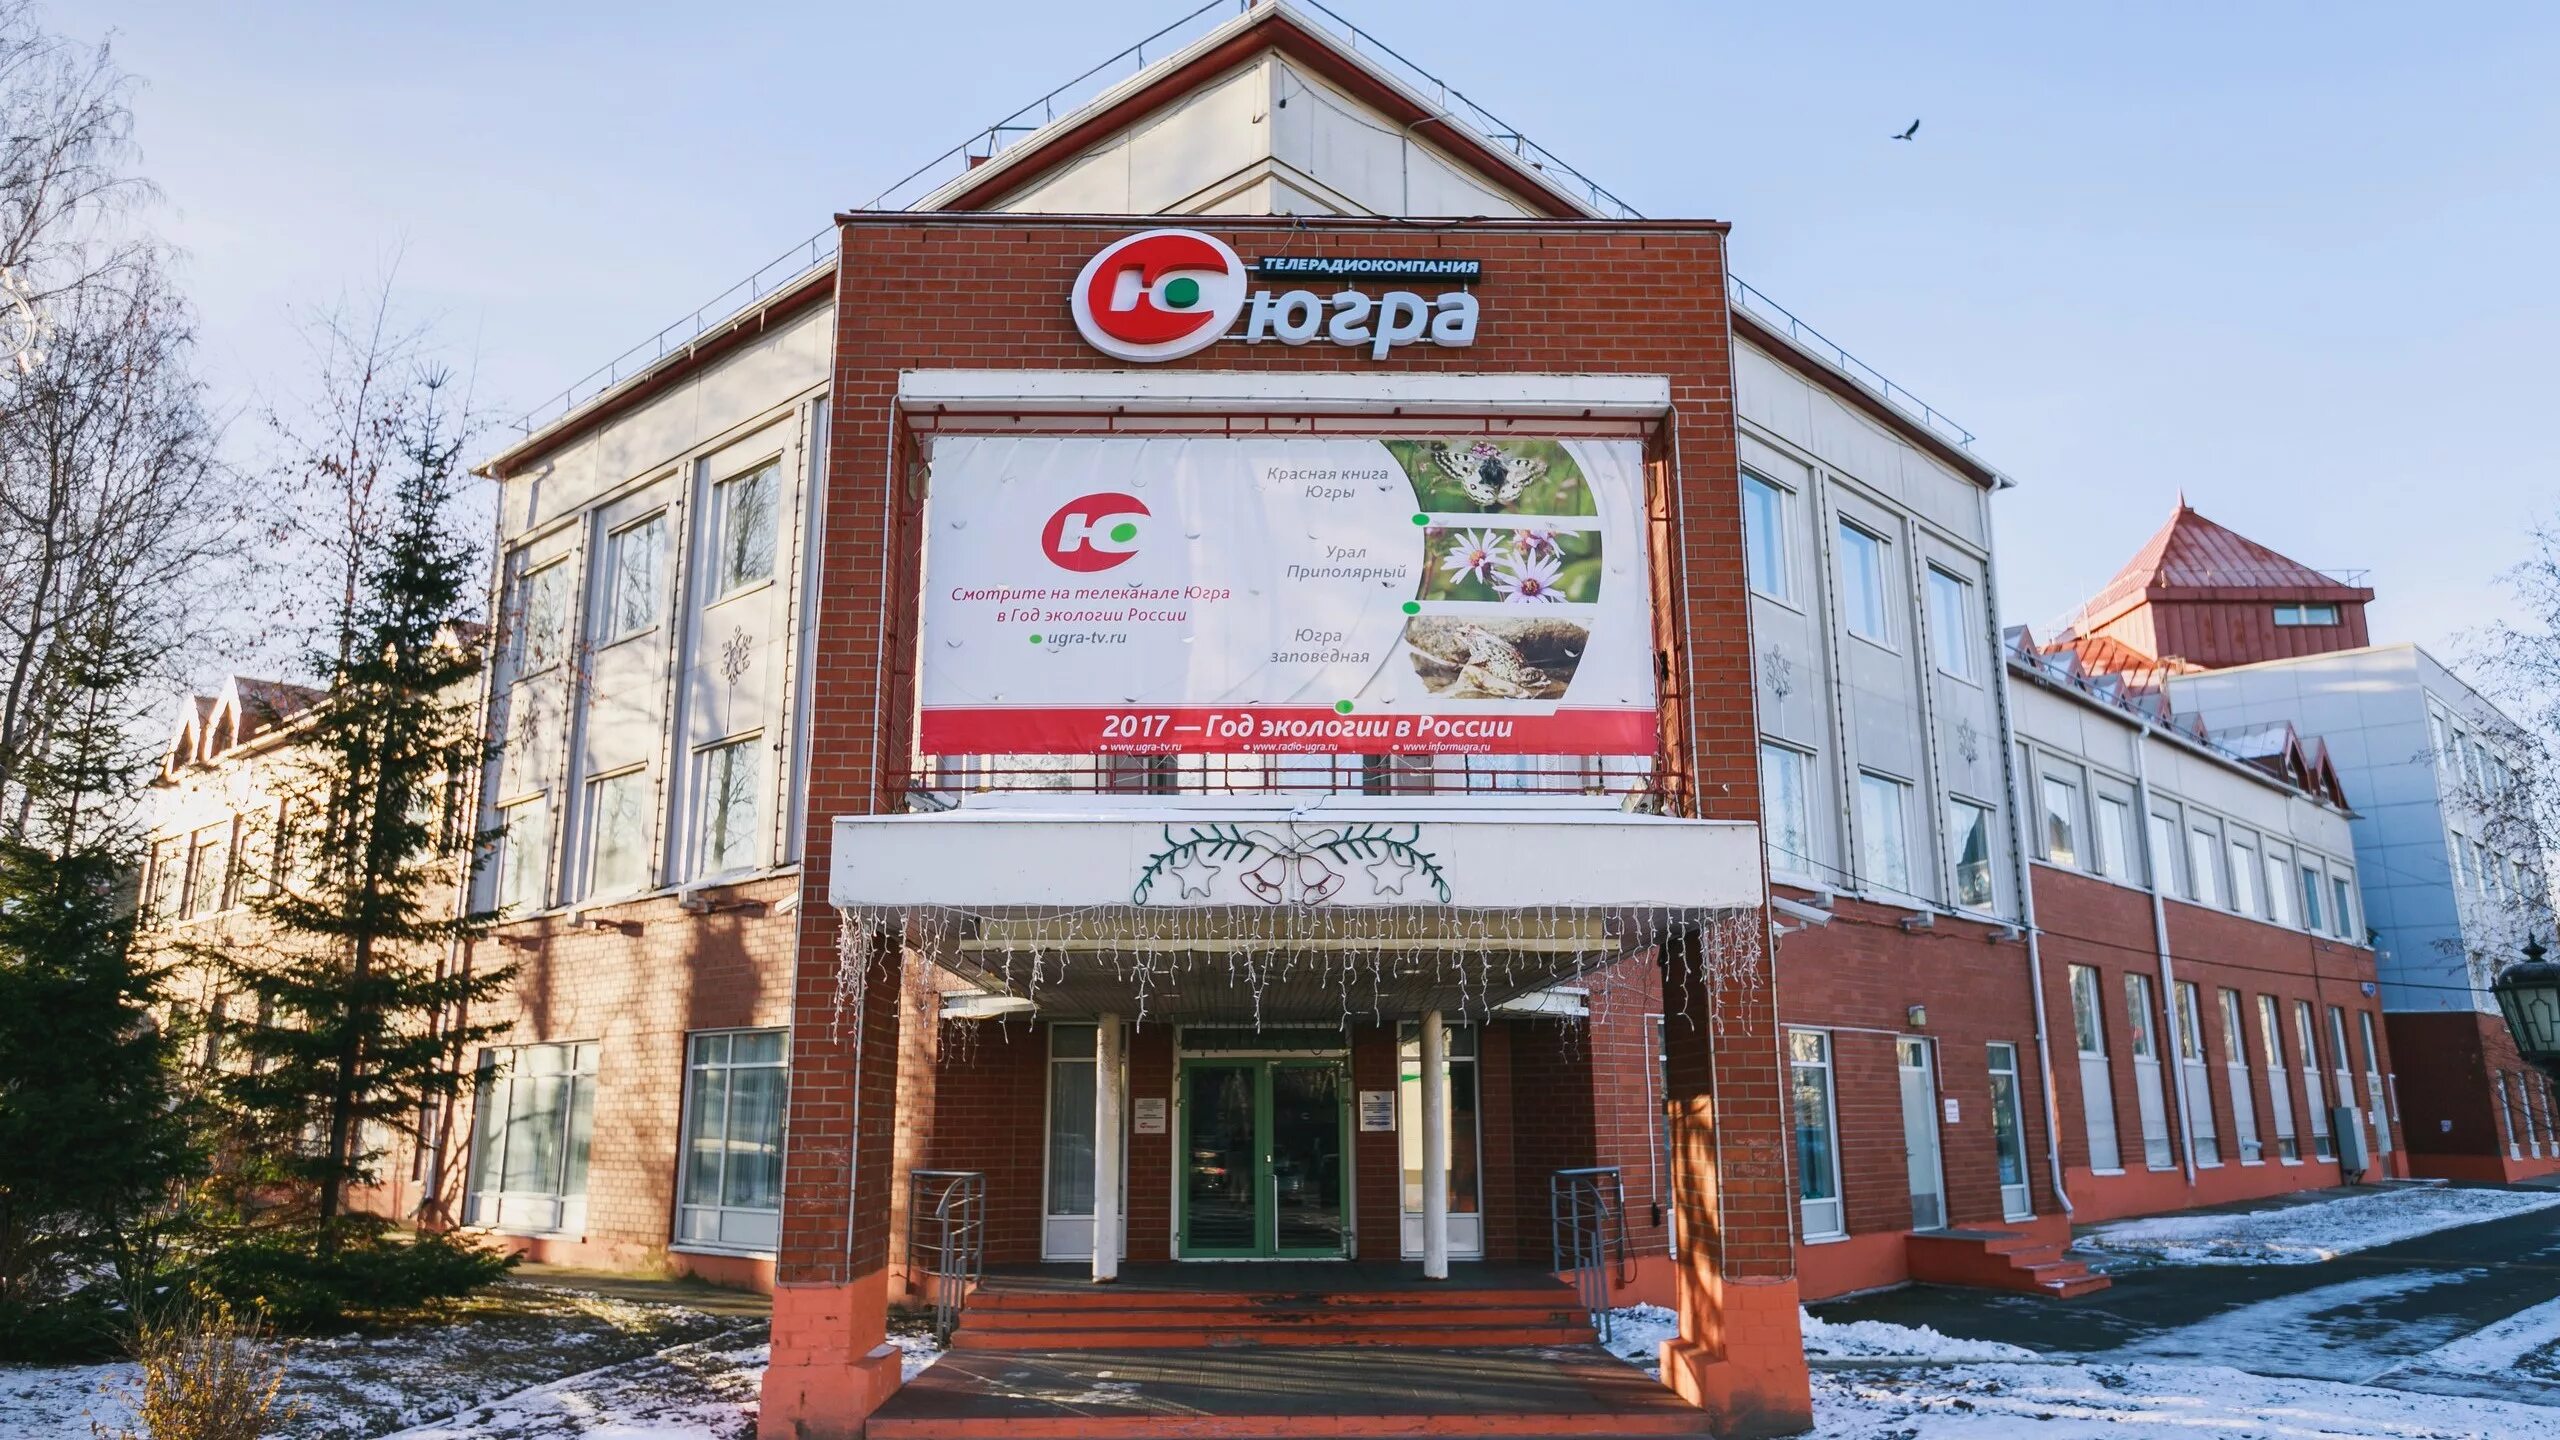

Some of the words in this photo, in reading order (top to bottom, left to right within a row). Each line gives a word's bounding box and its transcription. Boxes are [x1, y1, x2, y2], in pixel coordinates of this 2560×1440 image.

[1263, 257, 1480, 274] ТЕЛЕРАДИОКОМПАНИЯ
[1266, 466, 1337, 484] Красная
[1341, 469, 1390, 481] книга
[1305, 485, 1356, 502] Югры
[1325, 544, 1367, 563] Урал
[1286, 563, 1408, 582] Приполярный
[951, 586, 1047, 604] Смотрите
[1050, 589, 1070, 601] на
[1074, 588, 1180, 601] телеканале
[1183, 585, 1231, 604] Югра
[996, 611, 1006, 623] в
[1011, 607, 1041, 623] Год
[1044, 610, 1124, 623] экологии
[1127, 607, 1187, 623] России
[1047, 630, 1127, 646] ugra-tv.ru
[1294, 628, 1343, 647] Югра
[1270, 647, 1371, 664] заповедная
[1102, 714, 1171, 738] 2017
[1205, 713, 1255, 738] Год
[1259, 719, 1390, 738] экологии
[1394, 719, 1411, 738] в
[1416, 714, 1514, 738] России
[1110, 742, 1182, 753] www.ugra-tv.ru
[1252, 742, 1339, 753] www.radio-ugra.ru
[1402, 742, 1491, 753] www.informugra.ru
